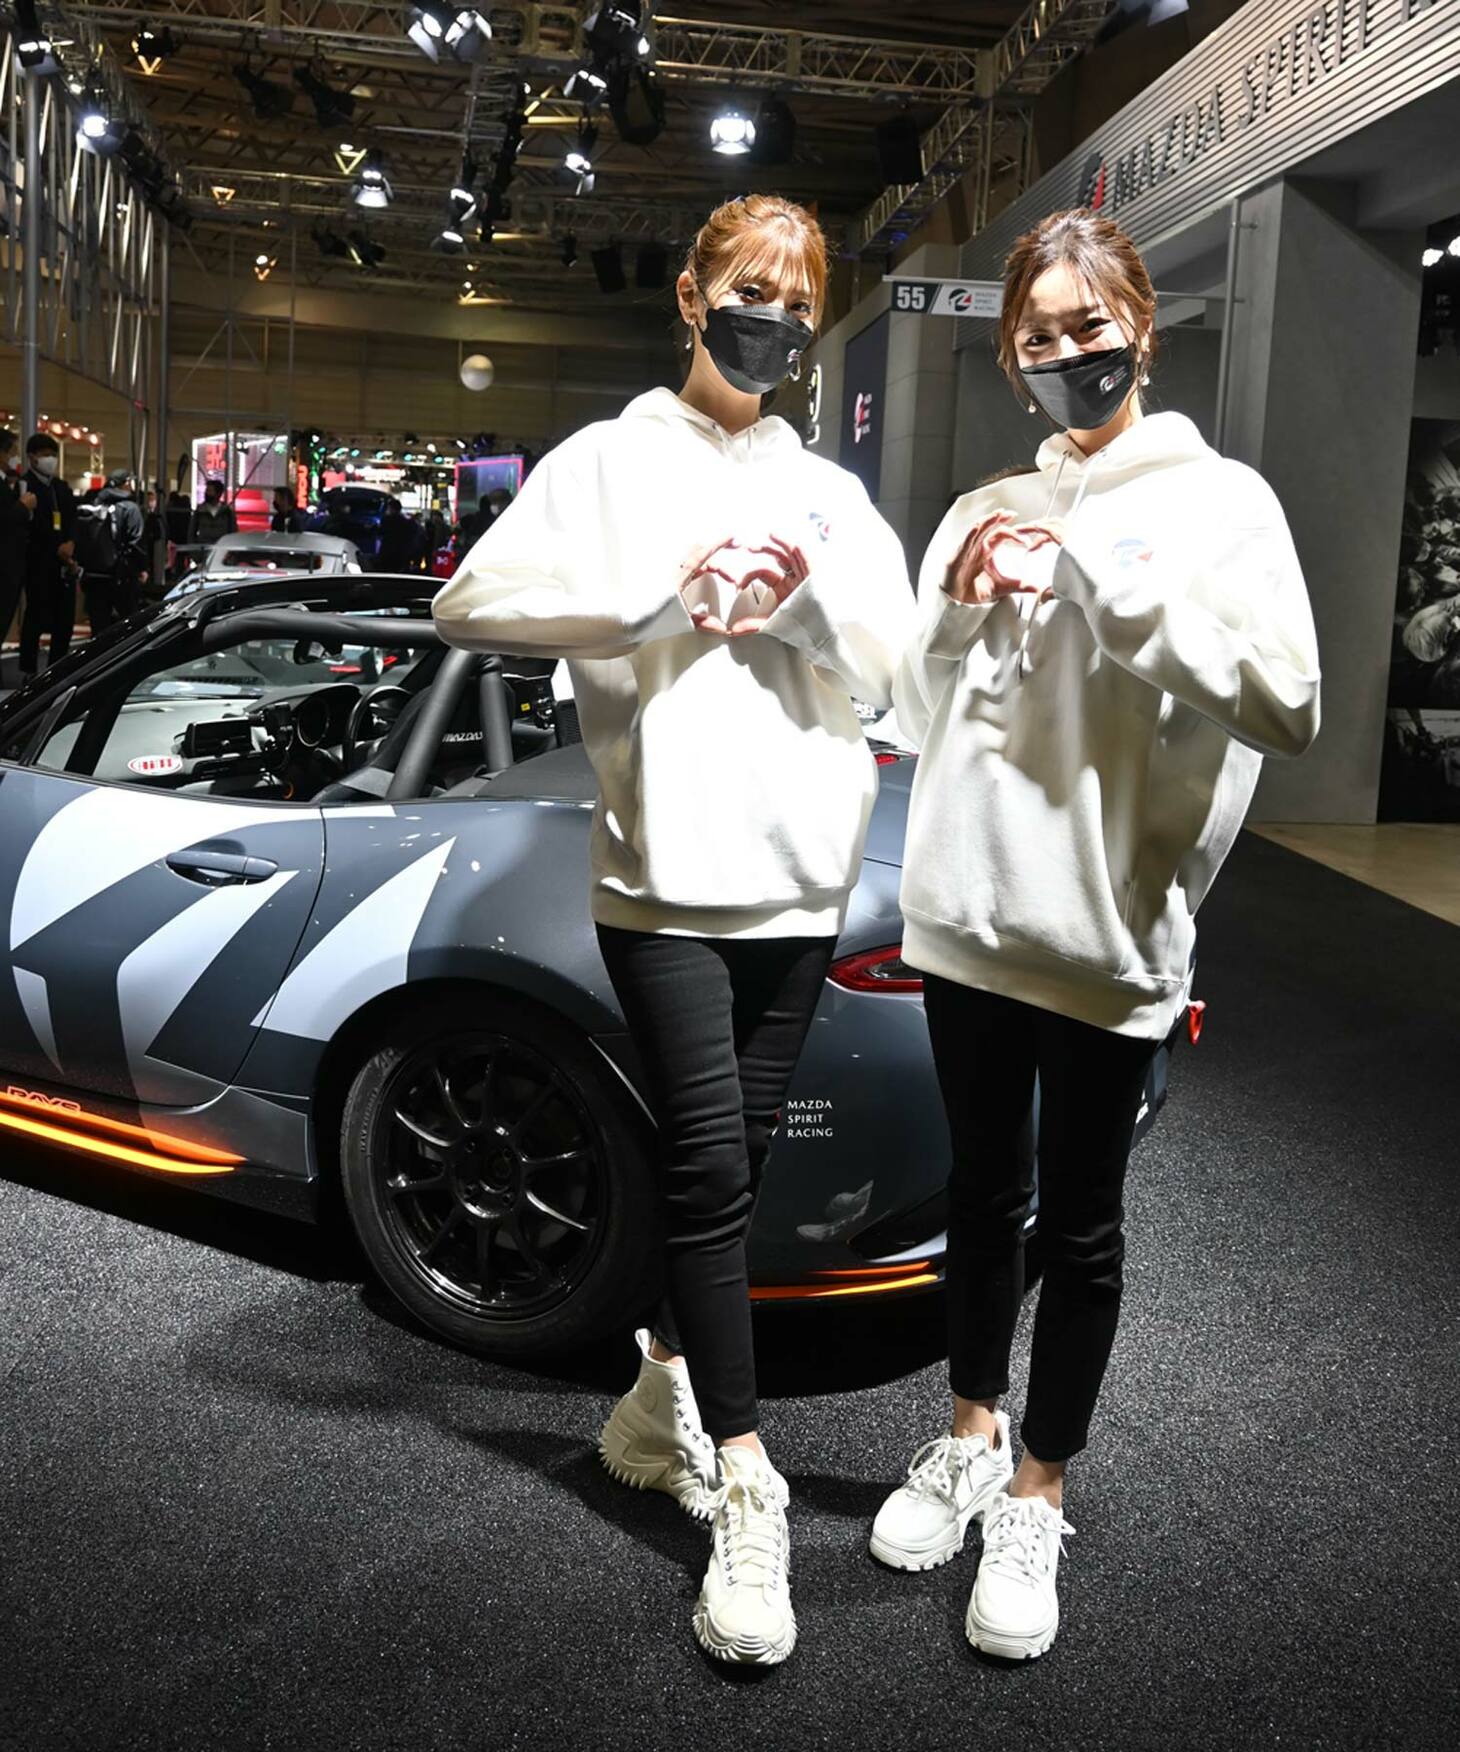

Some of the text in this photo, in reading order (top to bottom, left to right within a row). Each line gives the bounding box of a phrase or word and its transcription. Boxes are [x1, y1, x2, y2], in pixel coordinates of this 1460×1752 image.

[1112, 83, 1223, 212] MAZDA
[897, 285, 926, 310] 55
[787, 1099, 833, 1110] MAZDA
[787, 1113, 825, 1125] SPIRIT
[787, 1127, 833, 1138] RACING
